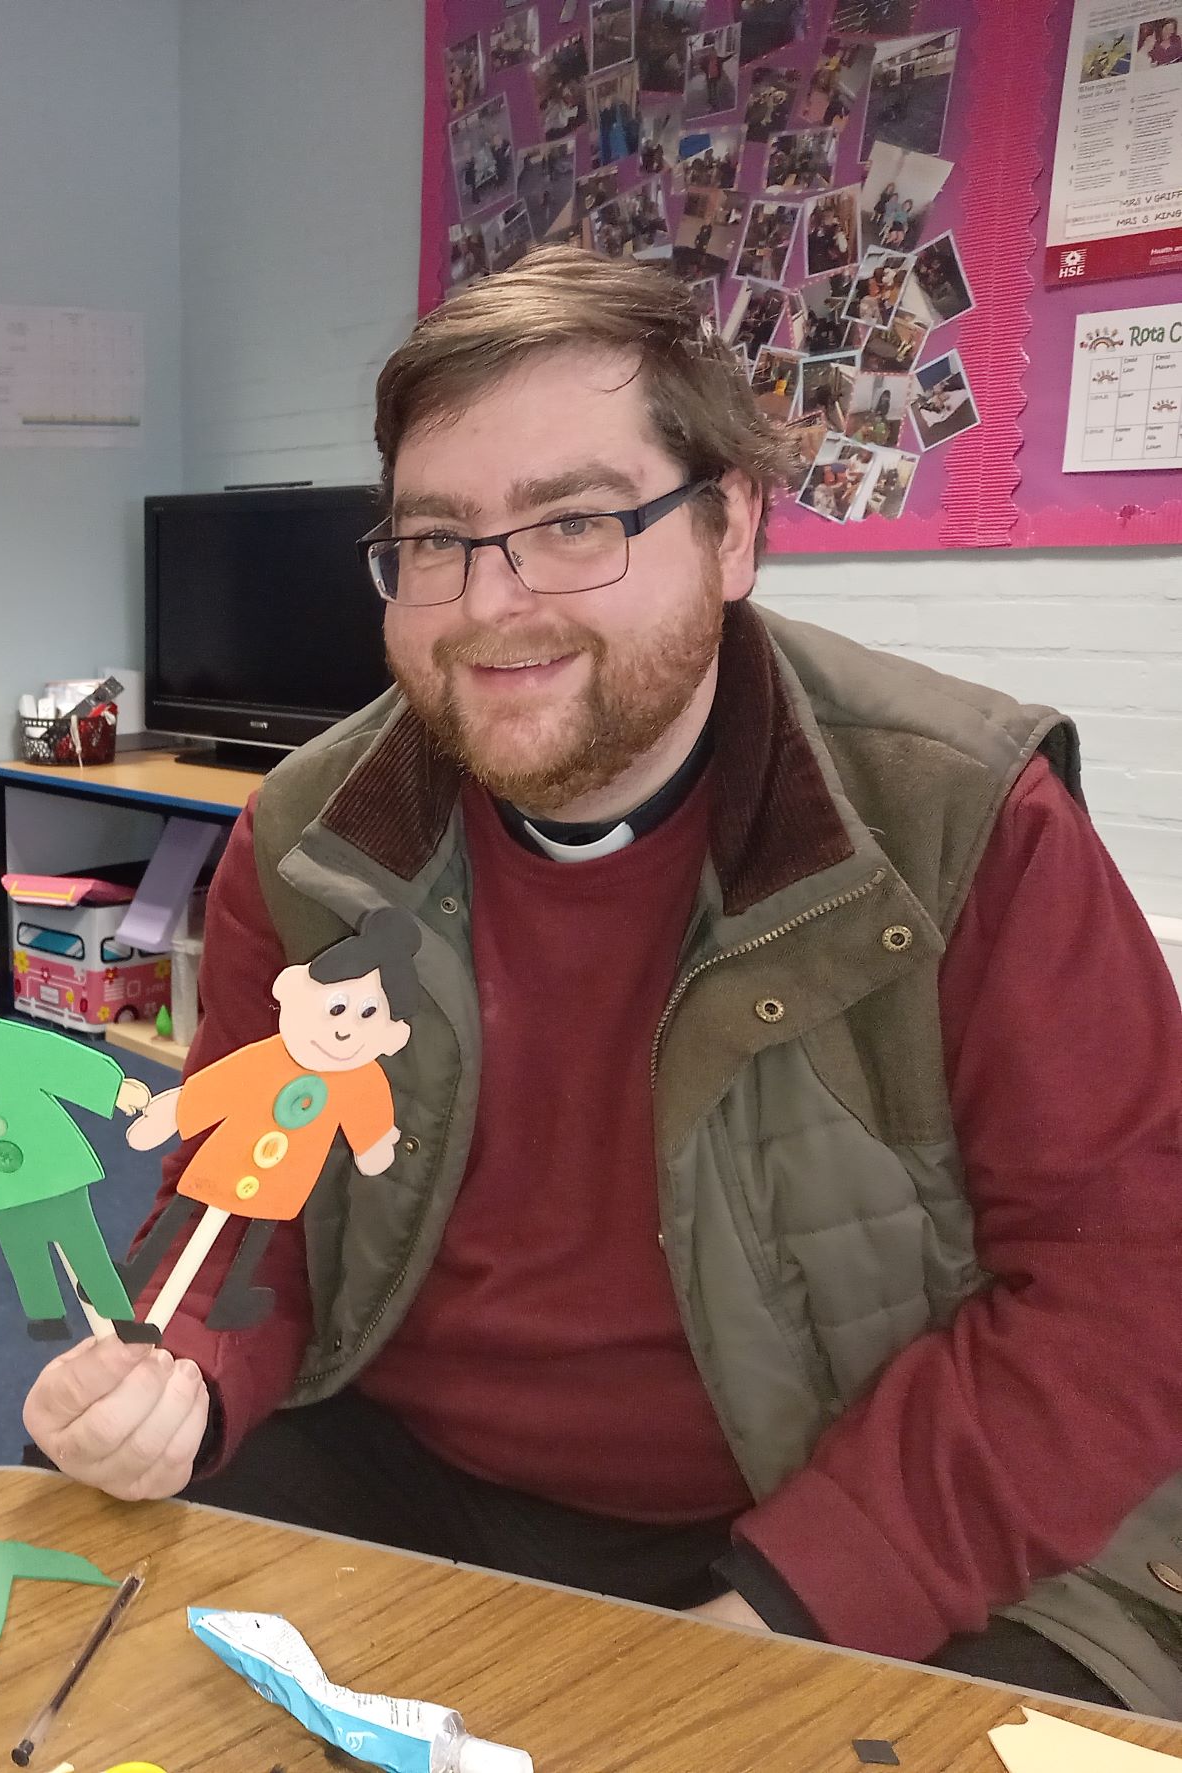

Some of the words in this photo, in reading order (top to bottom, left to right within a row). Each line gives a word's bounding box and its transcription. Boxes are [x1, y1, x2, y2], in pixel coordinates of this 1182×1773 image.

[1116, 216, 1137, 227] MRS
[1059, 265, 1085, 278] HSE
[1129, 325, 1165, 346] Rota
